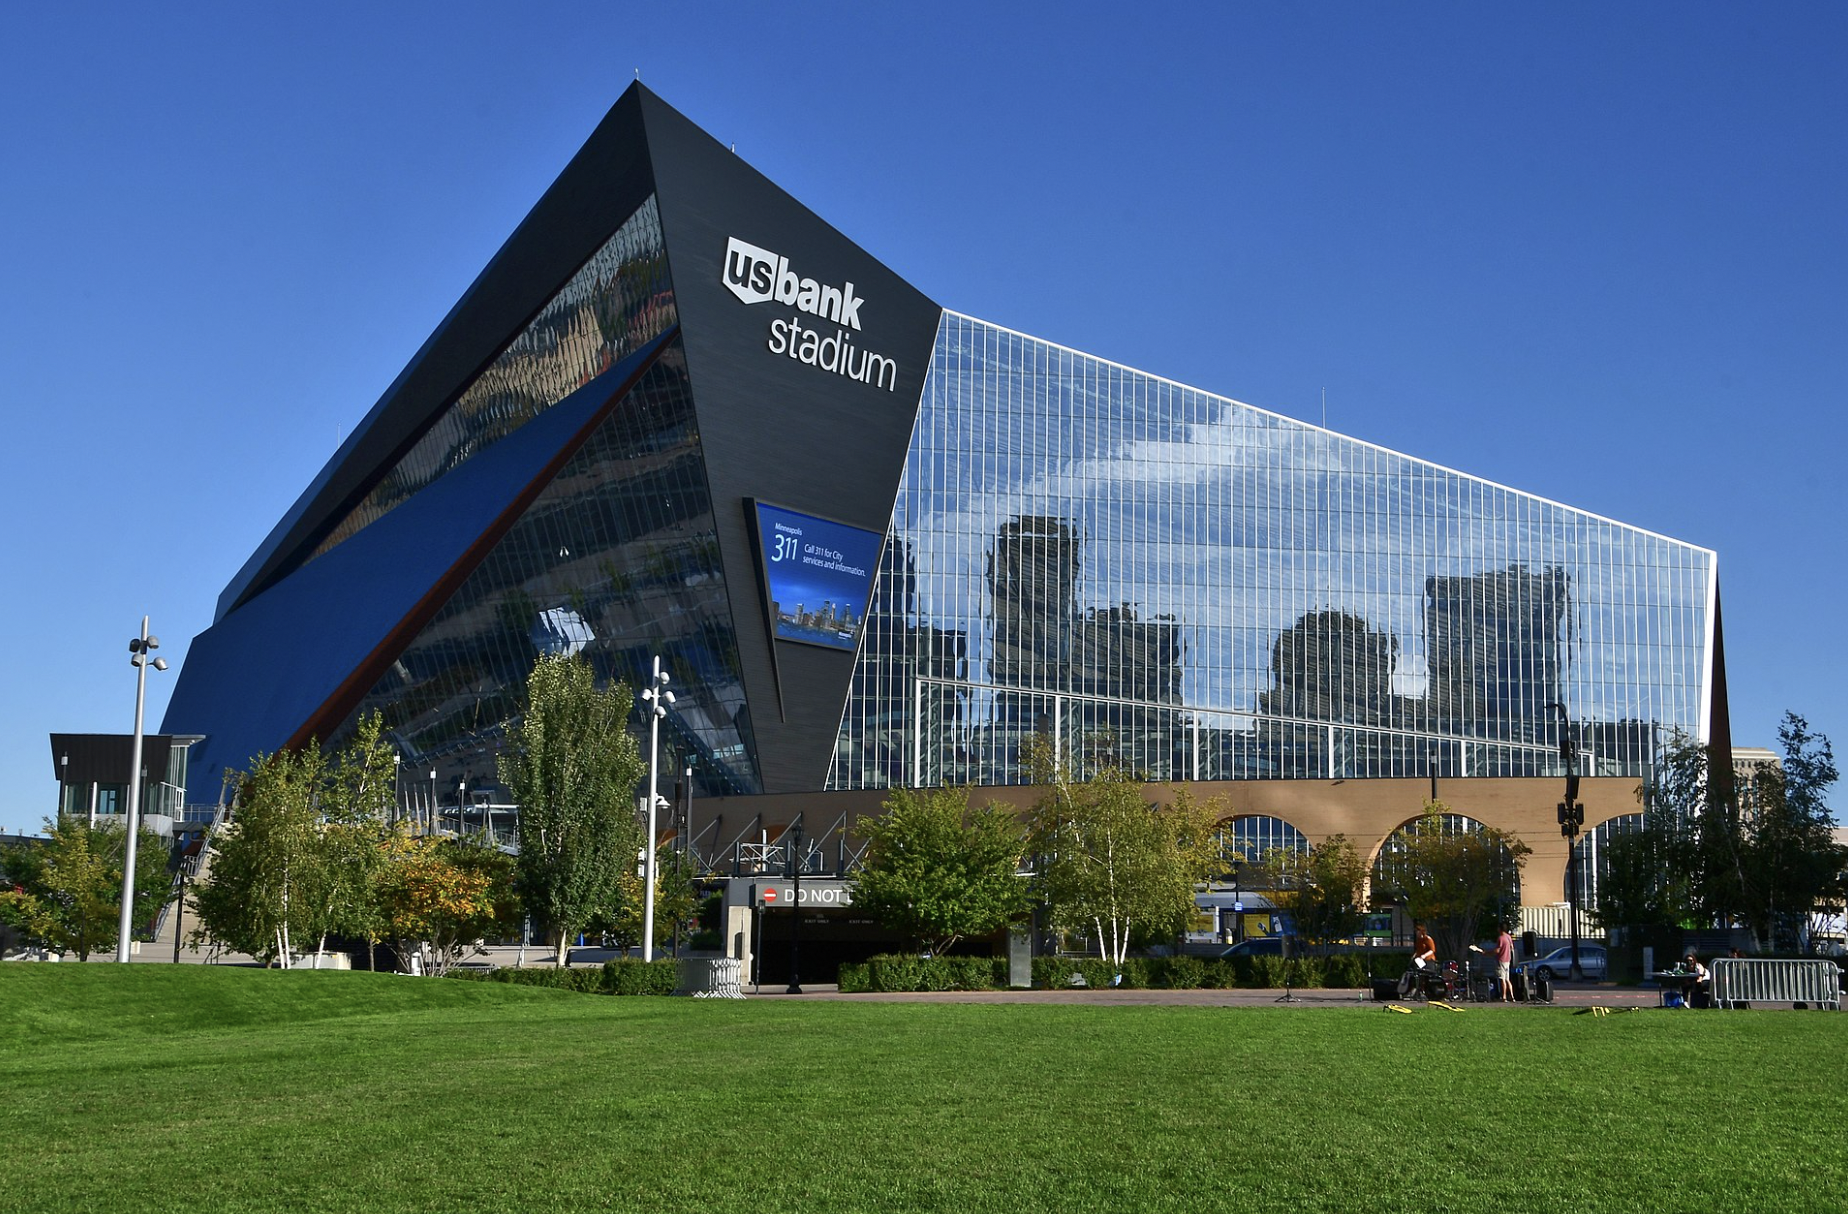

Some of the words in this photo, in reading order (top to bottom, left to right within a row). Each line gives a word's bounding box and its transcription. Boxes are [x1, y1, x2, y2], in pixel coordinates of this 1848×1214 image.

[768, 317, 897, 392] stadium
[775, 522, 802, 536] Minneapolis
[771, 533, 798, 562] 311
[804, 544, 814, 554] Call
[815, 546, 824, 556] 311
[832, 550, 844, 562] City
[803, 555, 824, 567] services
[824, 560, 834, 570] and
[835, 562, 866, 576] information.
[784, 888, 808, 903] DO
[811, 888, 844, 903] NOT
